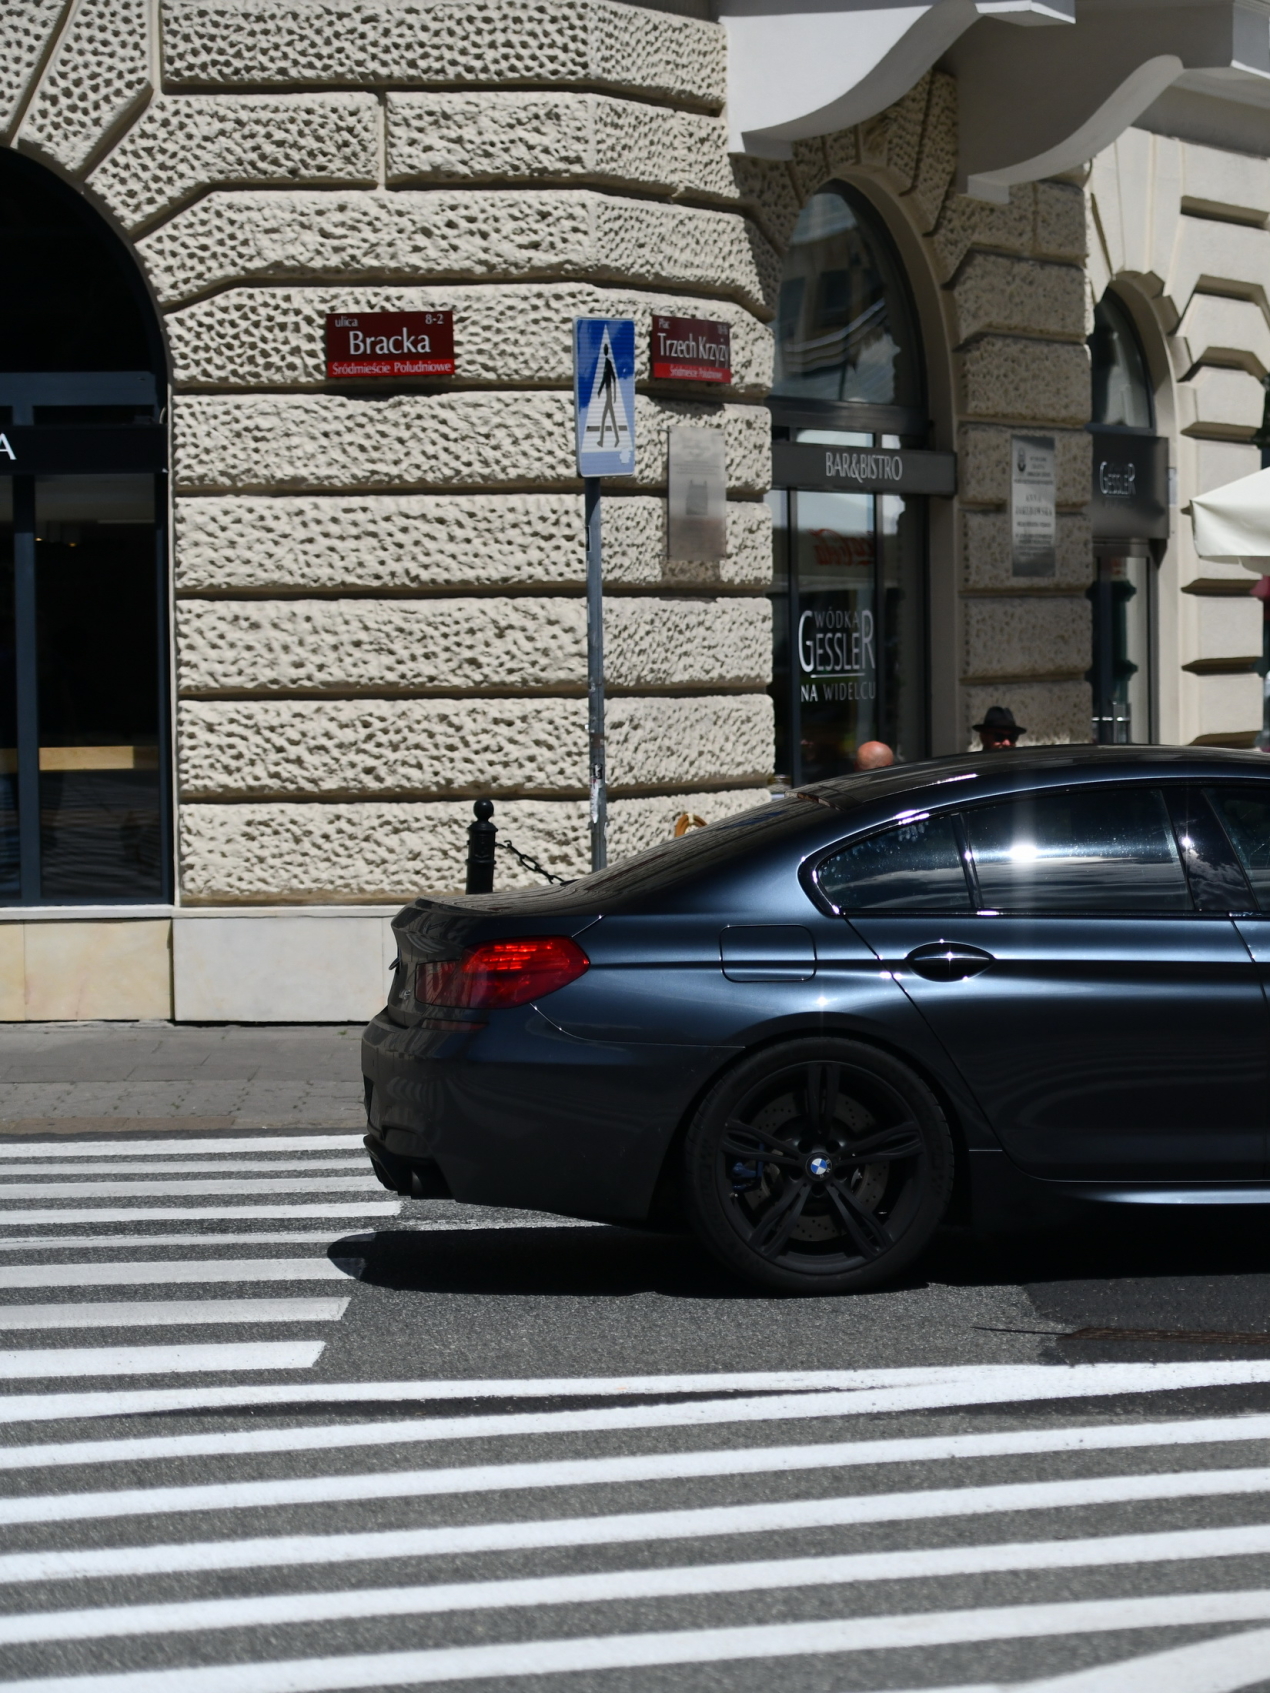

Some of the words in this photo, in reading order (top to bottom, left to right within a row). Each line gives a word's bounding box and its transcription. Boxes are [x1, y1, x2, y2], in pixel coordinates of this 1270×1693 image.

[335, 316, 358, 327] ulica
[425, 314, 444, 324] 8-2
[349, 327, 431, 355] Bracka
[657, 333, 697, 358] Trzech
[698, 337, 730, 369] Krzyży
[332, 362, 391, 375] Śródmieście
[394, 360, 451, 373] Południowe
[825, 452, 903, 483] BAR&BISTRO
[814, 606, 860, 629] WÓDKA
[799, 610, 876, 672] GESSLER
[801, 684, 819, 702] NA
[823, 682, 876, 701] WIDELCU
